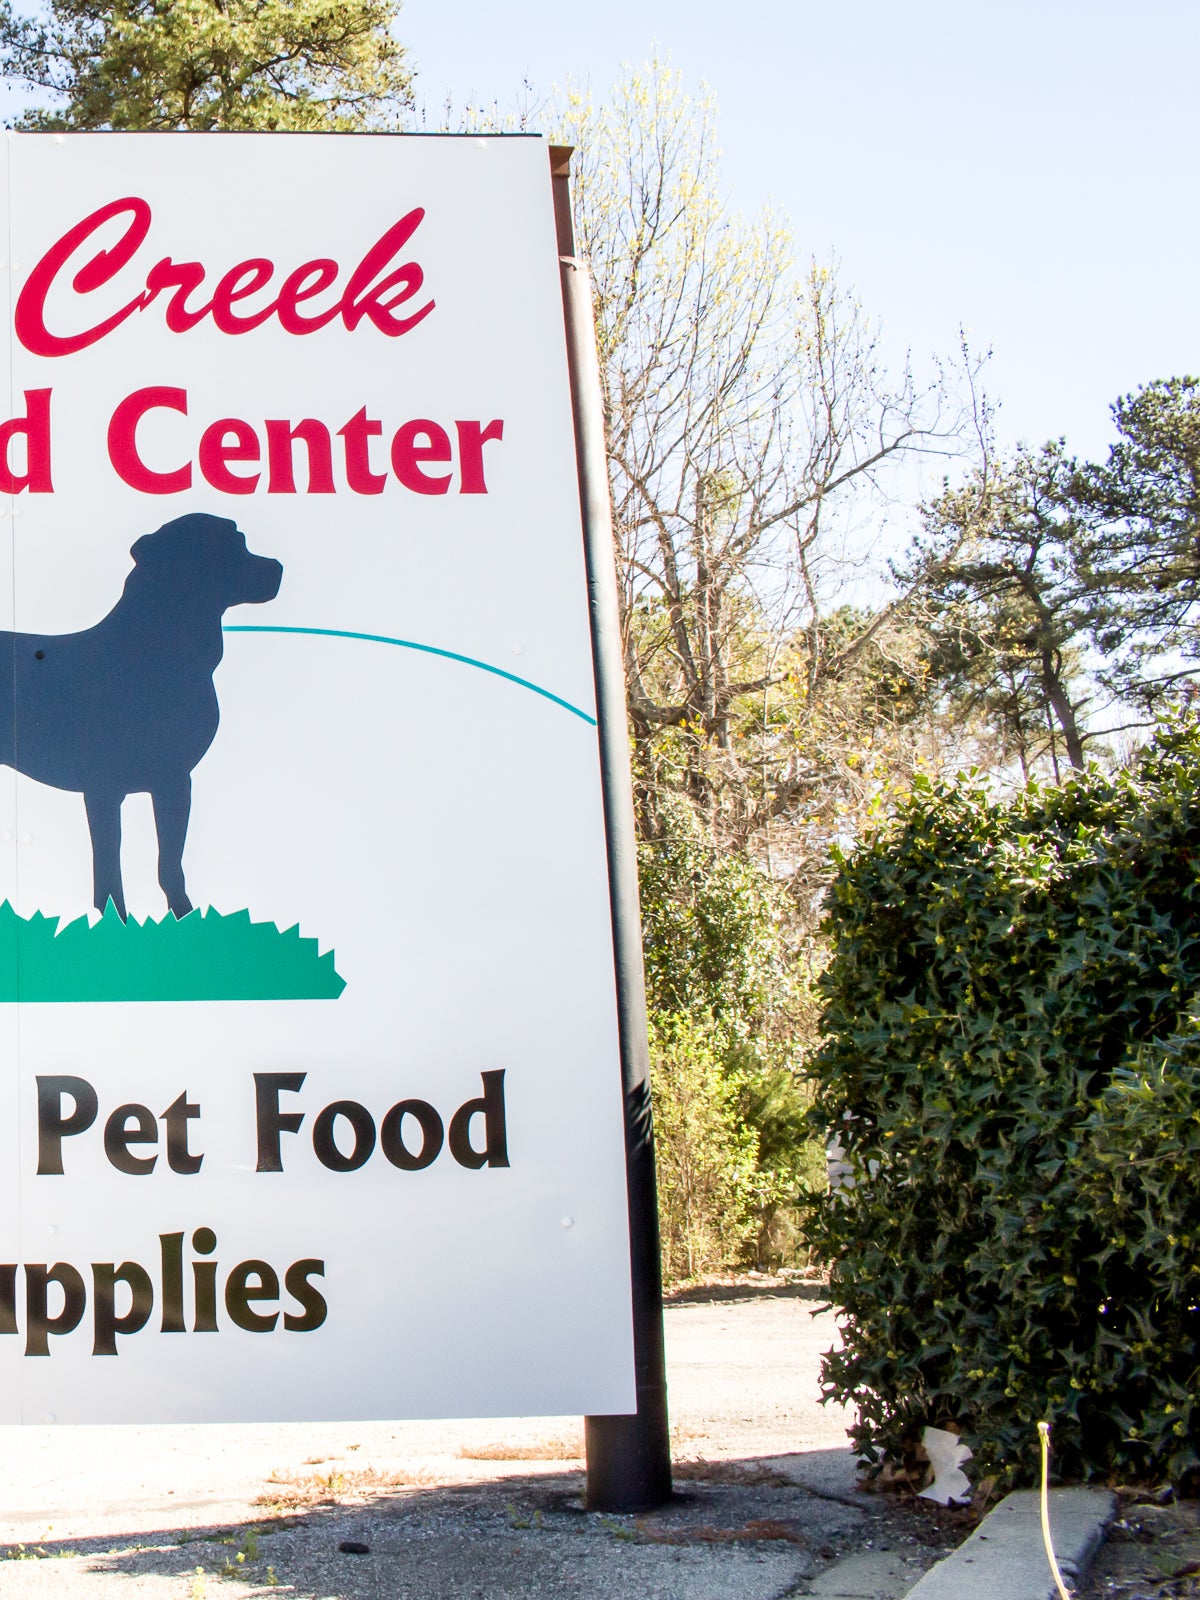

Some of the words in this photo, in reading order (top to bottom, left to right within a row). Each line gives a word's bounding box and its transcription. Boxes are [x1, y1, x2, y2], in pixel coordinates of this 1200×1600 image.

[15, 196, 436, 358] Creek
[107, 385, 504, 496] Center
[35, 1076, 205, 1176] Pet
[253, 1068, 511, 1173] Food
